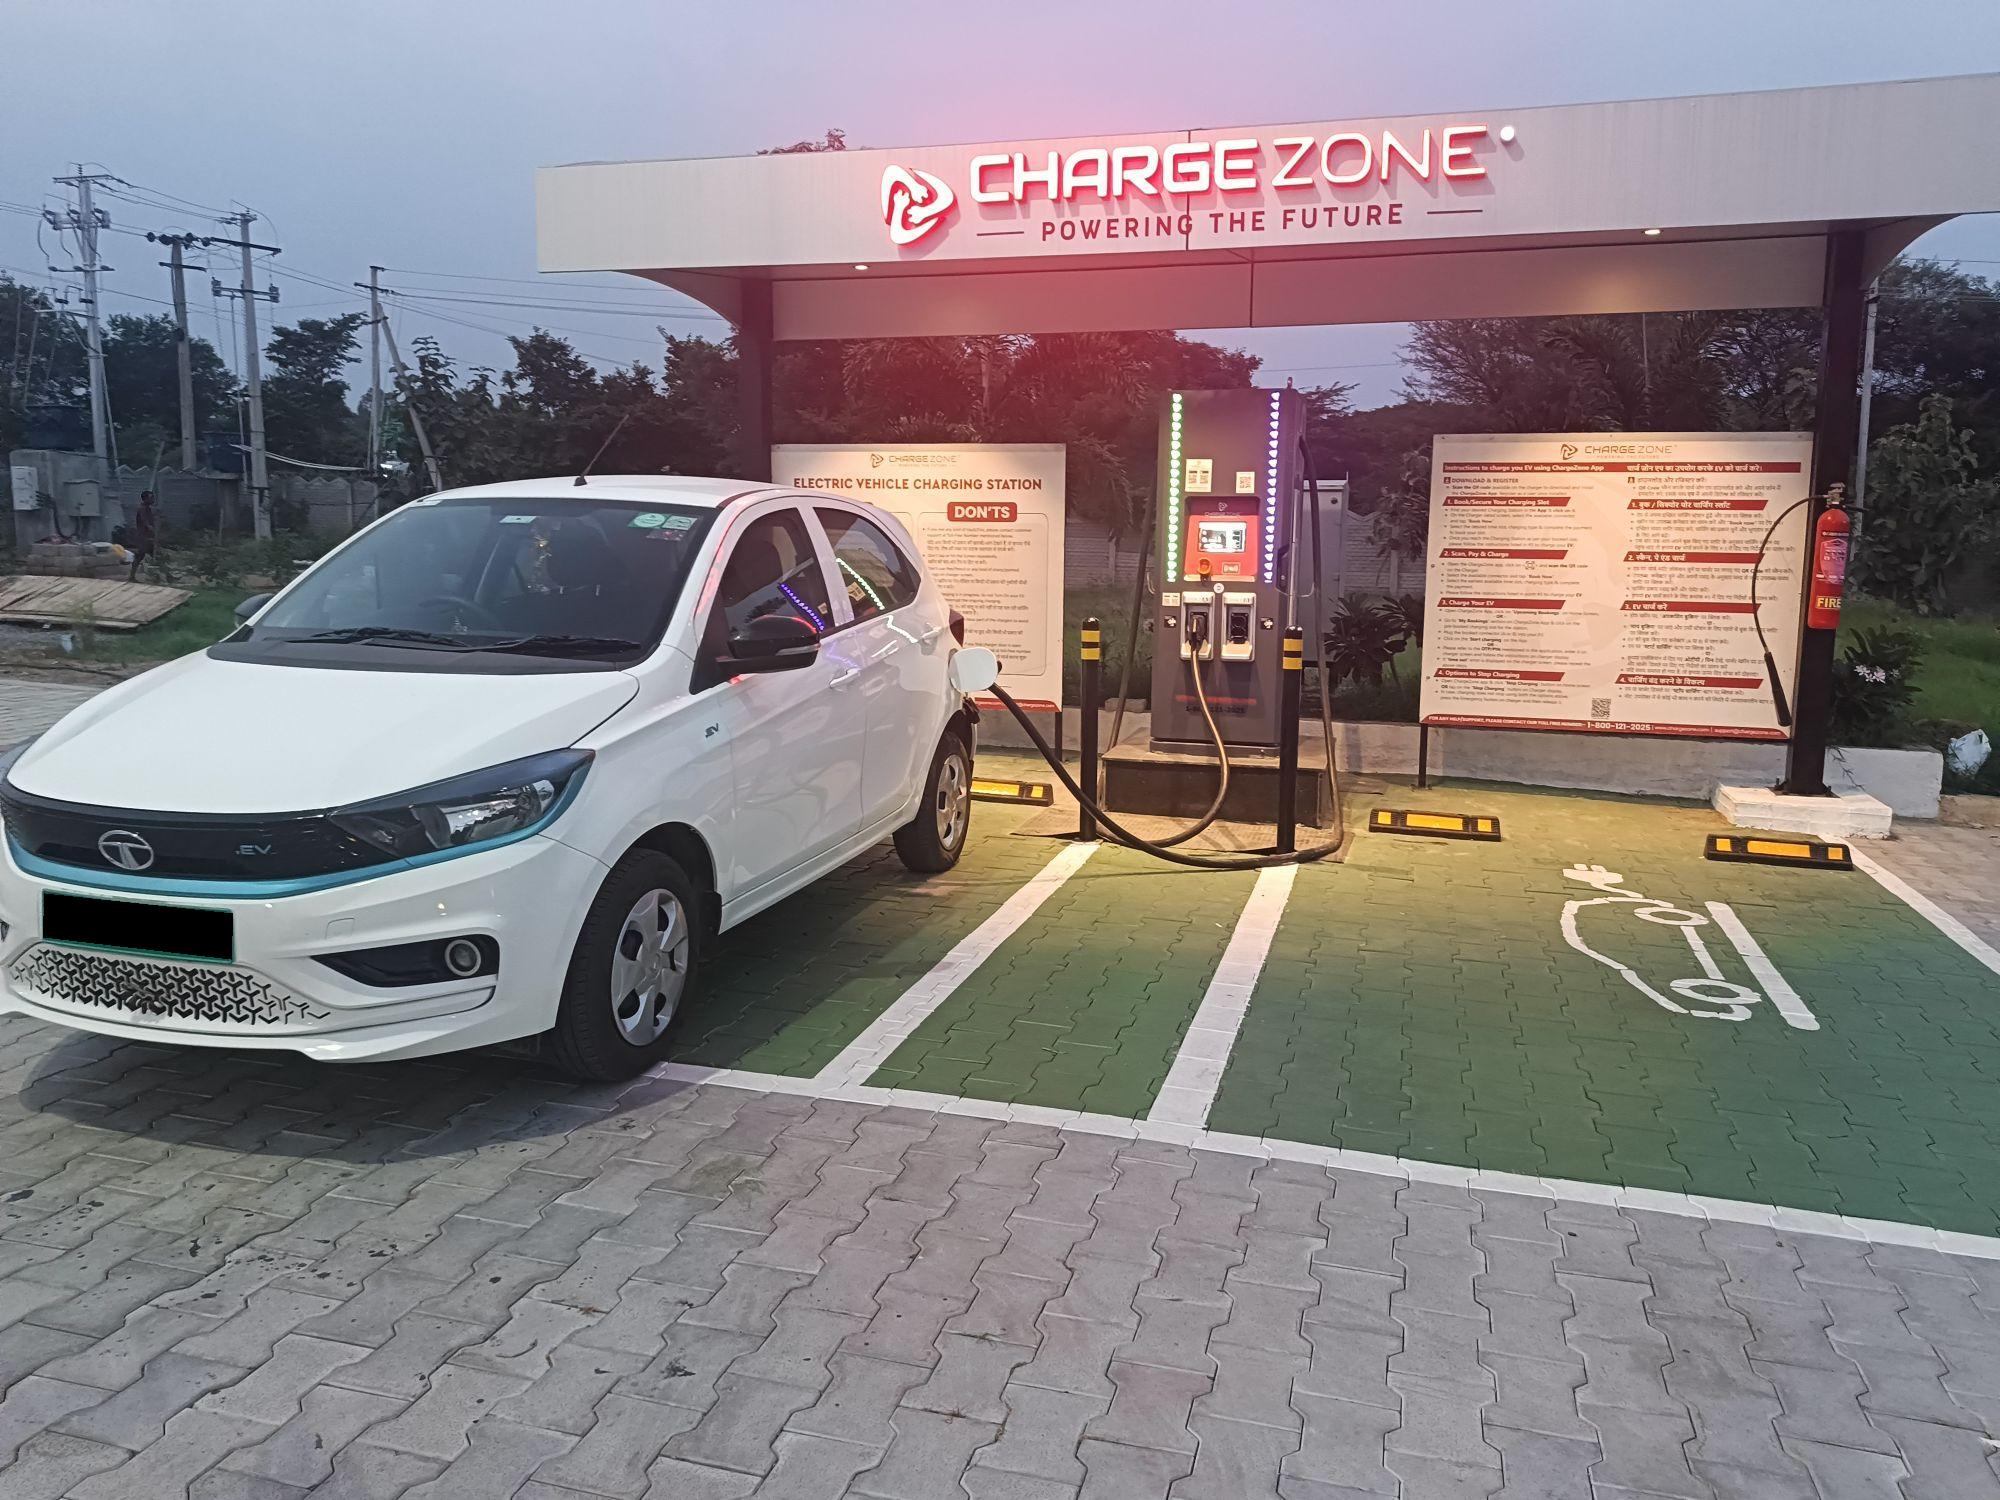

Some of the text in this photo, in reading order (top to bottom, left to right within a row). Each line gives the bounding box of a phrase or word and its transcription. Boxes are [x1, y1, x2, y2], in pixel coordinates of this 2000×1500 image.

[970, 125, 1488, 203] CHARGE ZONE
[1042, 203, 1403, 241] POWERING THE FUTURE
[1585, 445, 1673, 454] CHARGE ZONE
[889, 455, 957, 463] CHARGE ZONE
[793, 477, 1043, 490] ELECTRIC VEHICLE CHARGING STATION
[954, 505, 1011, 519] DON'TS
[1817, 597, 1842, 608] FIRE
[1586, 722, 1651, 732] 1-800-121-2025
